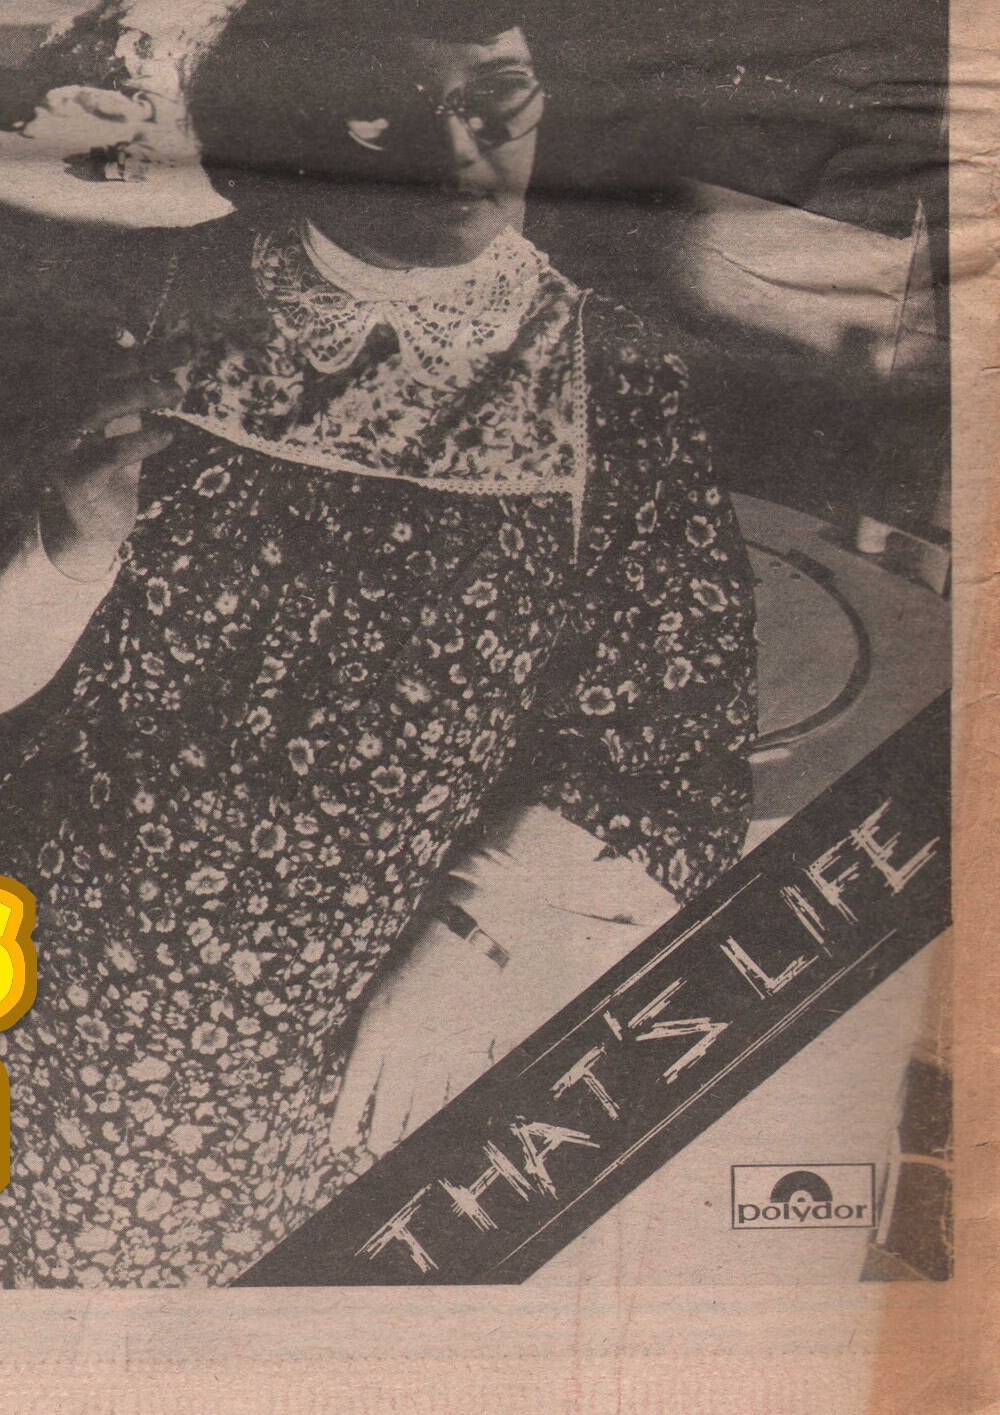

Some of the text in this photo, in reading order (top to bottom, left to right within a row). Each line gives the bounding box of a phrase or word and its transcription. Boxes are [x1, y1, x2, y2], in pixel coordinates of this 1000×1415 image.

[353, 796, 941, 1274] THAT'S LIFE
[738, 1202, 868, 1224] polydor
